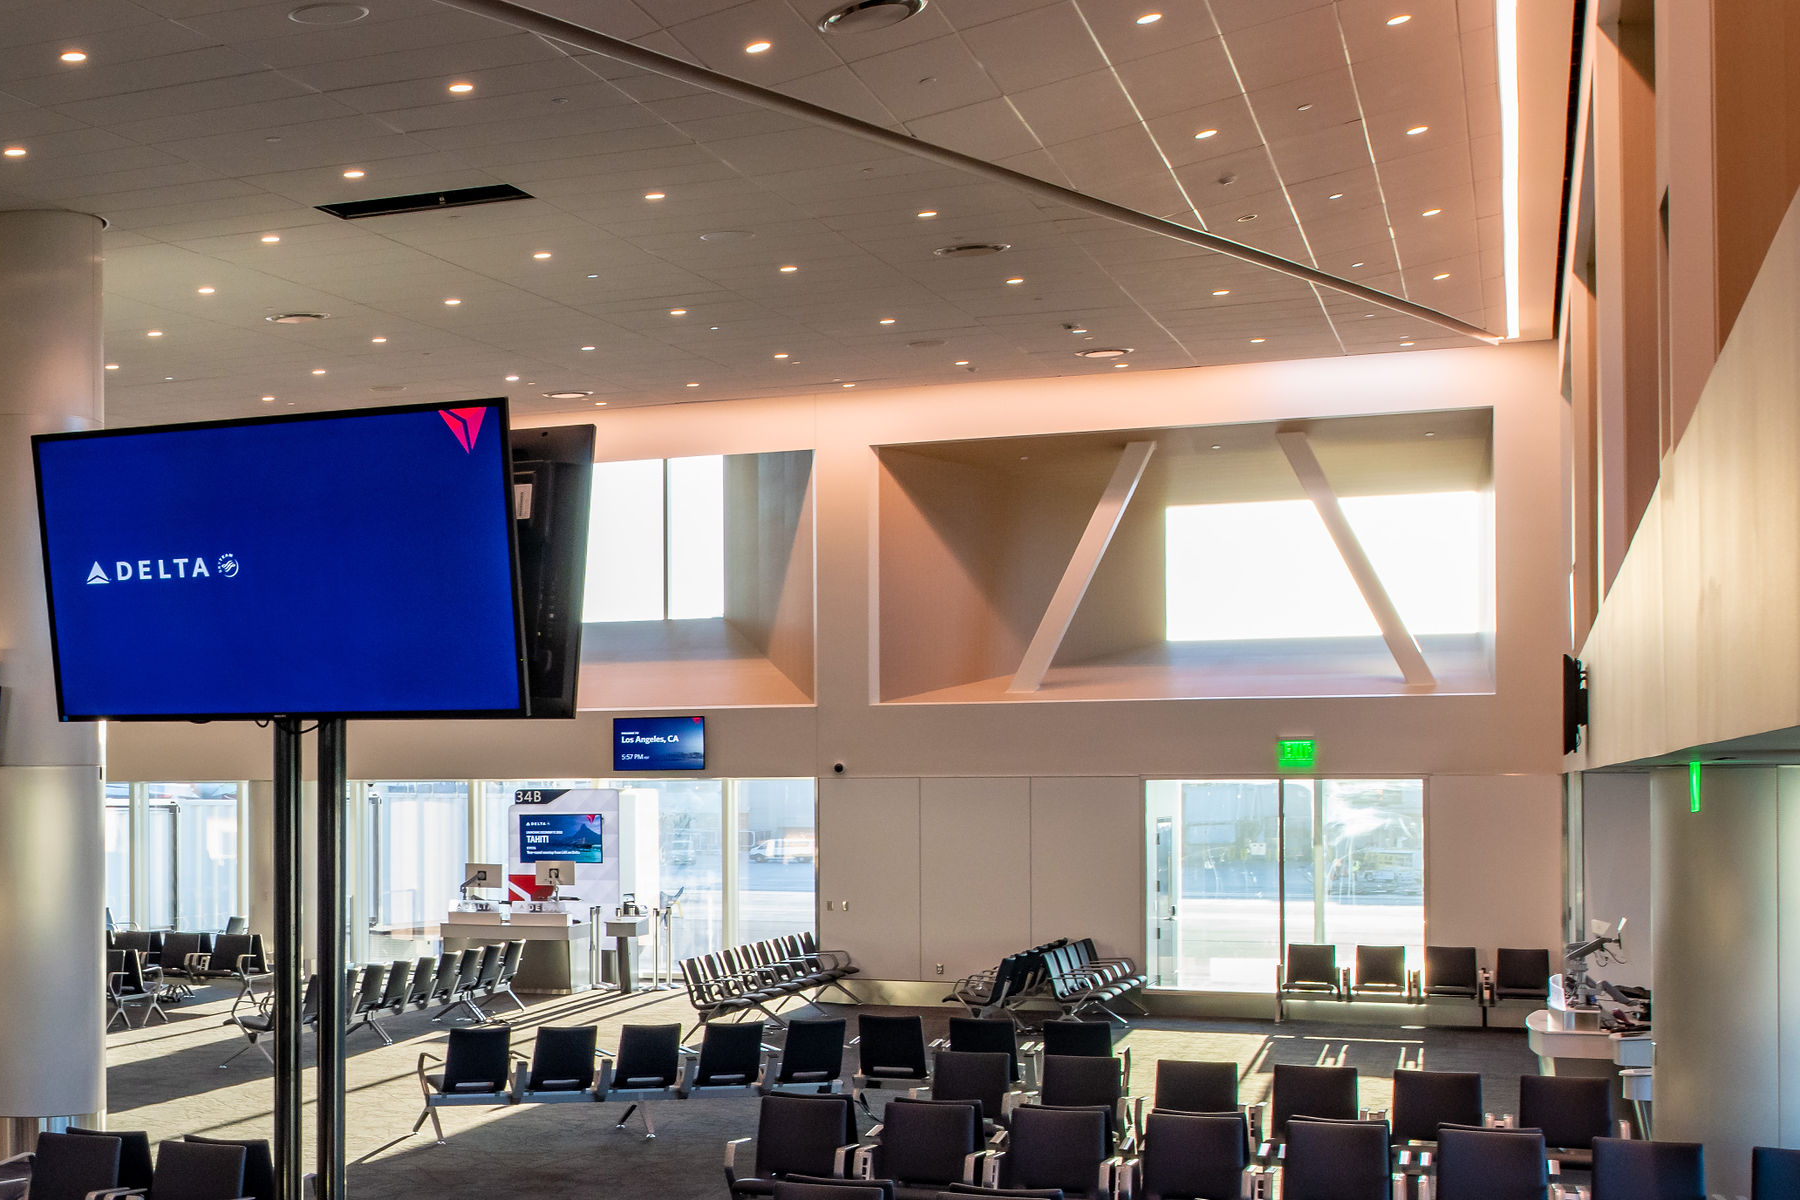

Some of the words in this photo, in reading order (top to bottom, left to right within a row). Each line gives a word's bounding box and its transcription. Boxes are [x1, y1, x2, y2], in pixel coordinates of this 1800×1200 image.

[115, 557, 210, 581] DELTA
[635, 735, 667, 745] Angeles,
[516, 790, 542, 803] 34B
[526, 835, 549, 843] TAHITI
